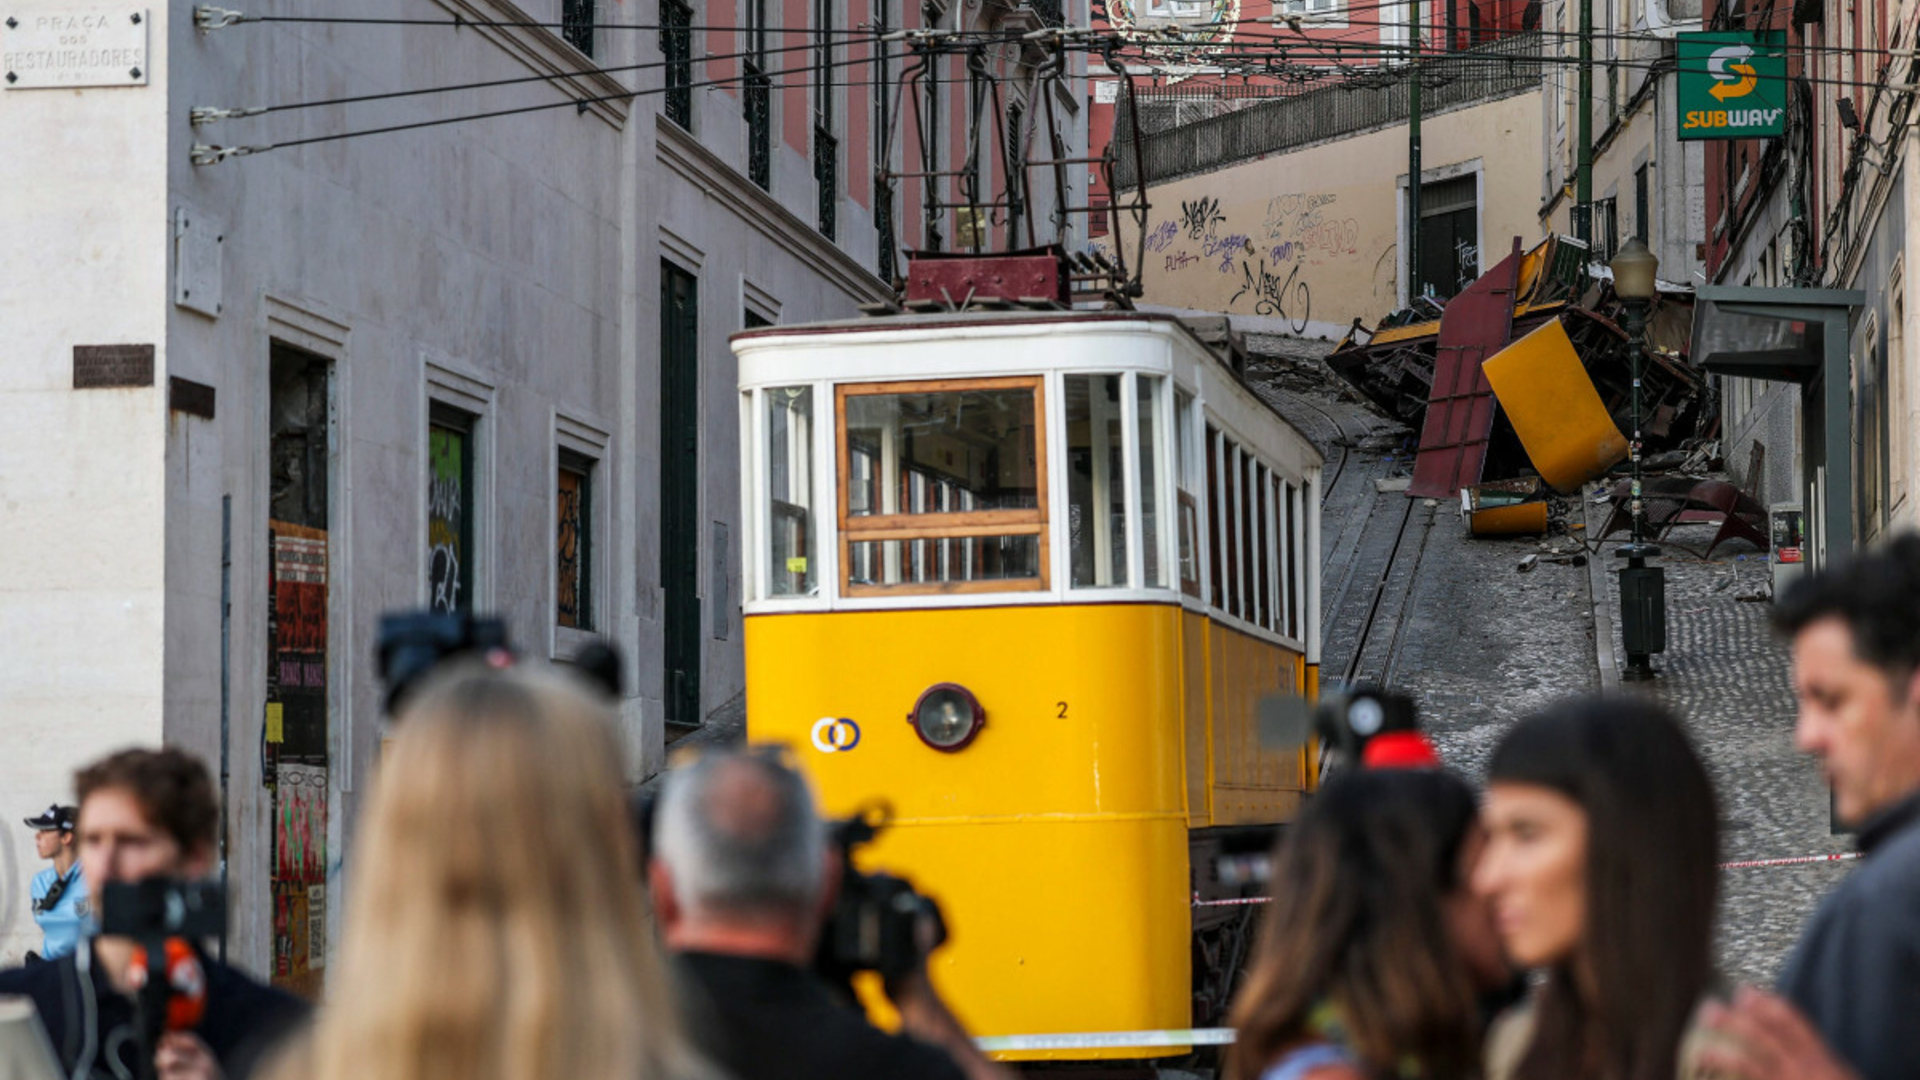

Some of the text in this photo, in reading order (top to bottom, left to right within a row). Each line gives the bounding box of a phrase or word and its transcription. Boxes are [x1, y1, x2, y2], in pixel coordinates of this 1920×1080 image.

[36, 15, 110, 33] PRAÇA
[59, 34, 88, 45] DOS
[4, 48, 142, 71] RESTAURADORES
[1683, 108, 1783, 129] SUBWAY
[1056, 701, 1069, 719] 2
